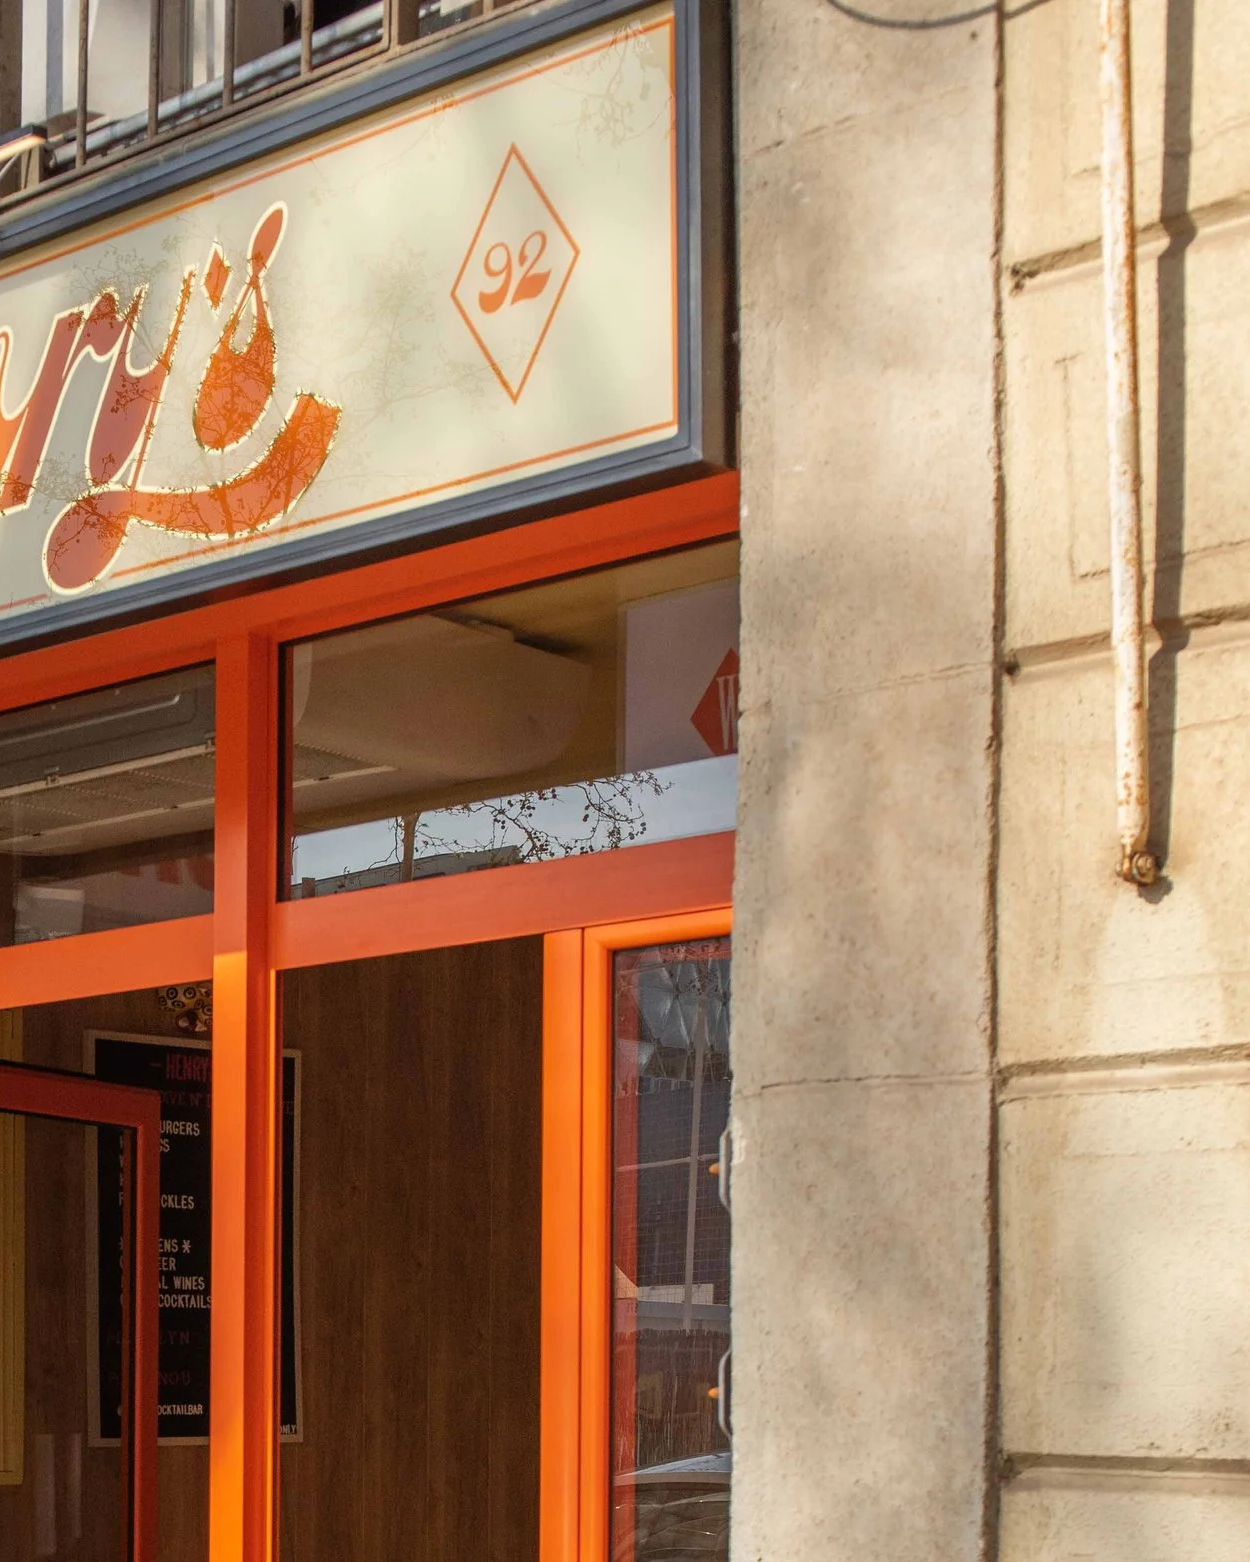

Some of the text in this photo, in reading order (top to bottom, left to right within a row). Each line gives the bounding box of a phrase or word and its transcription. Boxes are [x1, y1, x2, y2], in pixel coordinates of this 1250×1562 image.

[478, 229, 552, 314] 92
[160, 1120, 200, 1136] URGERS
[161, 1194, 195, 1209] CKLES
[173, 1276, 205, 1290] WINES
[158, 1403, 204, 1417] OCKTAILBAR
